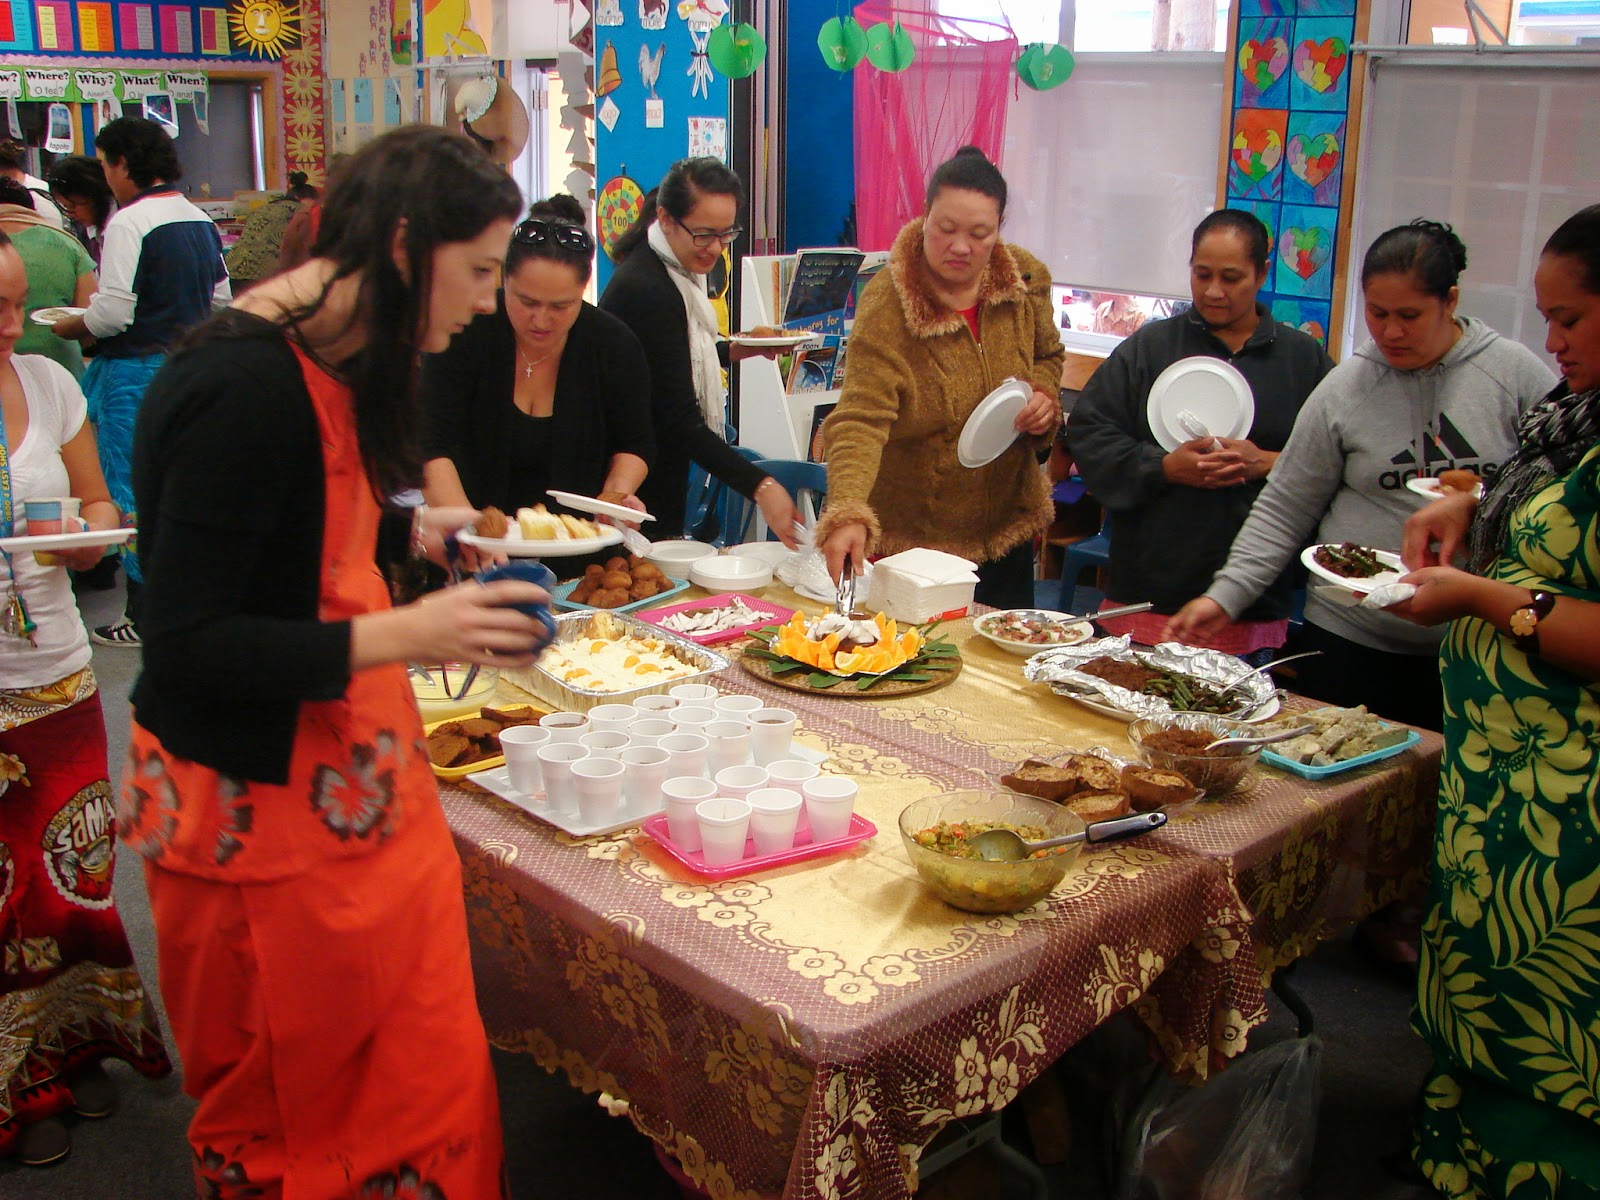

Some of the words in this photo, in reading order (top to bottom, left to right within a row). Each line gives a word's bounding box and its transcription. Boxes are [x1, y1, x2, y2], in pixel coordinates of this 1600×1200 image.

[25, 71, 69, 81] Where?
[78, 74, 114, 87] Why?
[122, 75, 159, 86] What?
[167, 74, 206, 86] When?
[613, 215, 627, 228] 100
[826, 315, 839, 327] for
